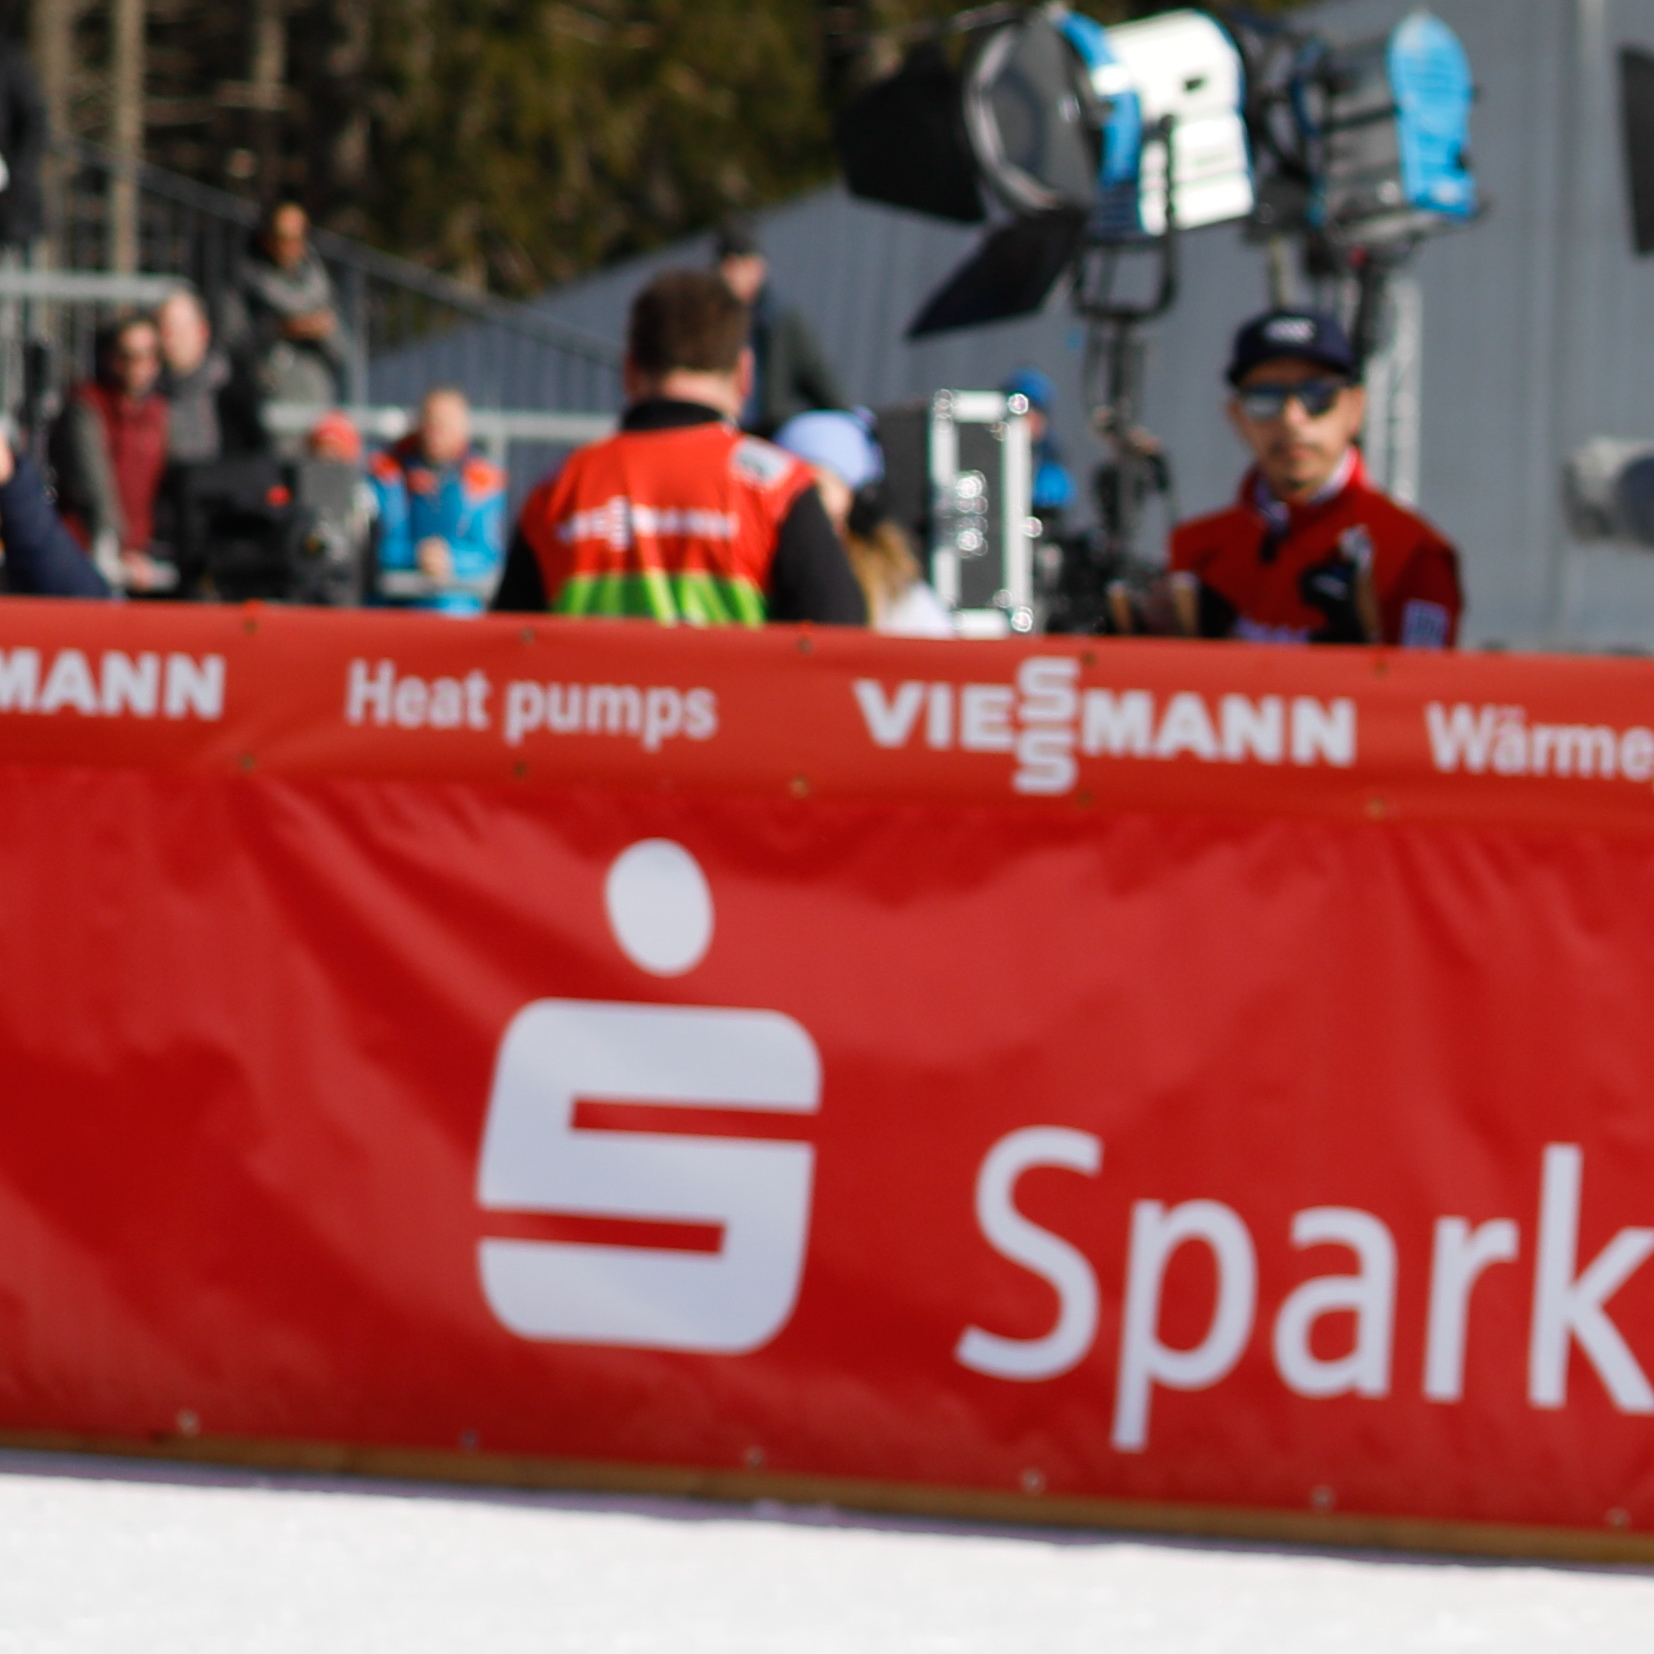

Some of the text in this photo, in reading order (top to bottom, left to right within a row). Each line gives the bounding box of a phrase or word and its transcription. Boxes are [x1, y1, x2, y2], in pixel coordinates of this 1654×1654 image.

[345, 657, 718, 752] Heat pumps
[853, 656, 1357, 796] VIESSMANN
